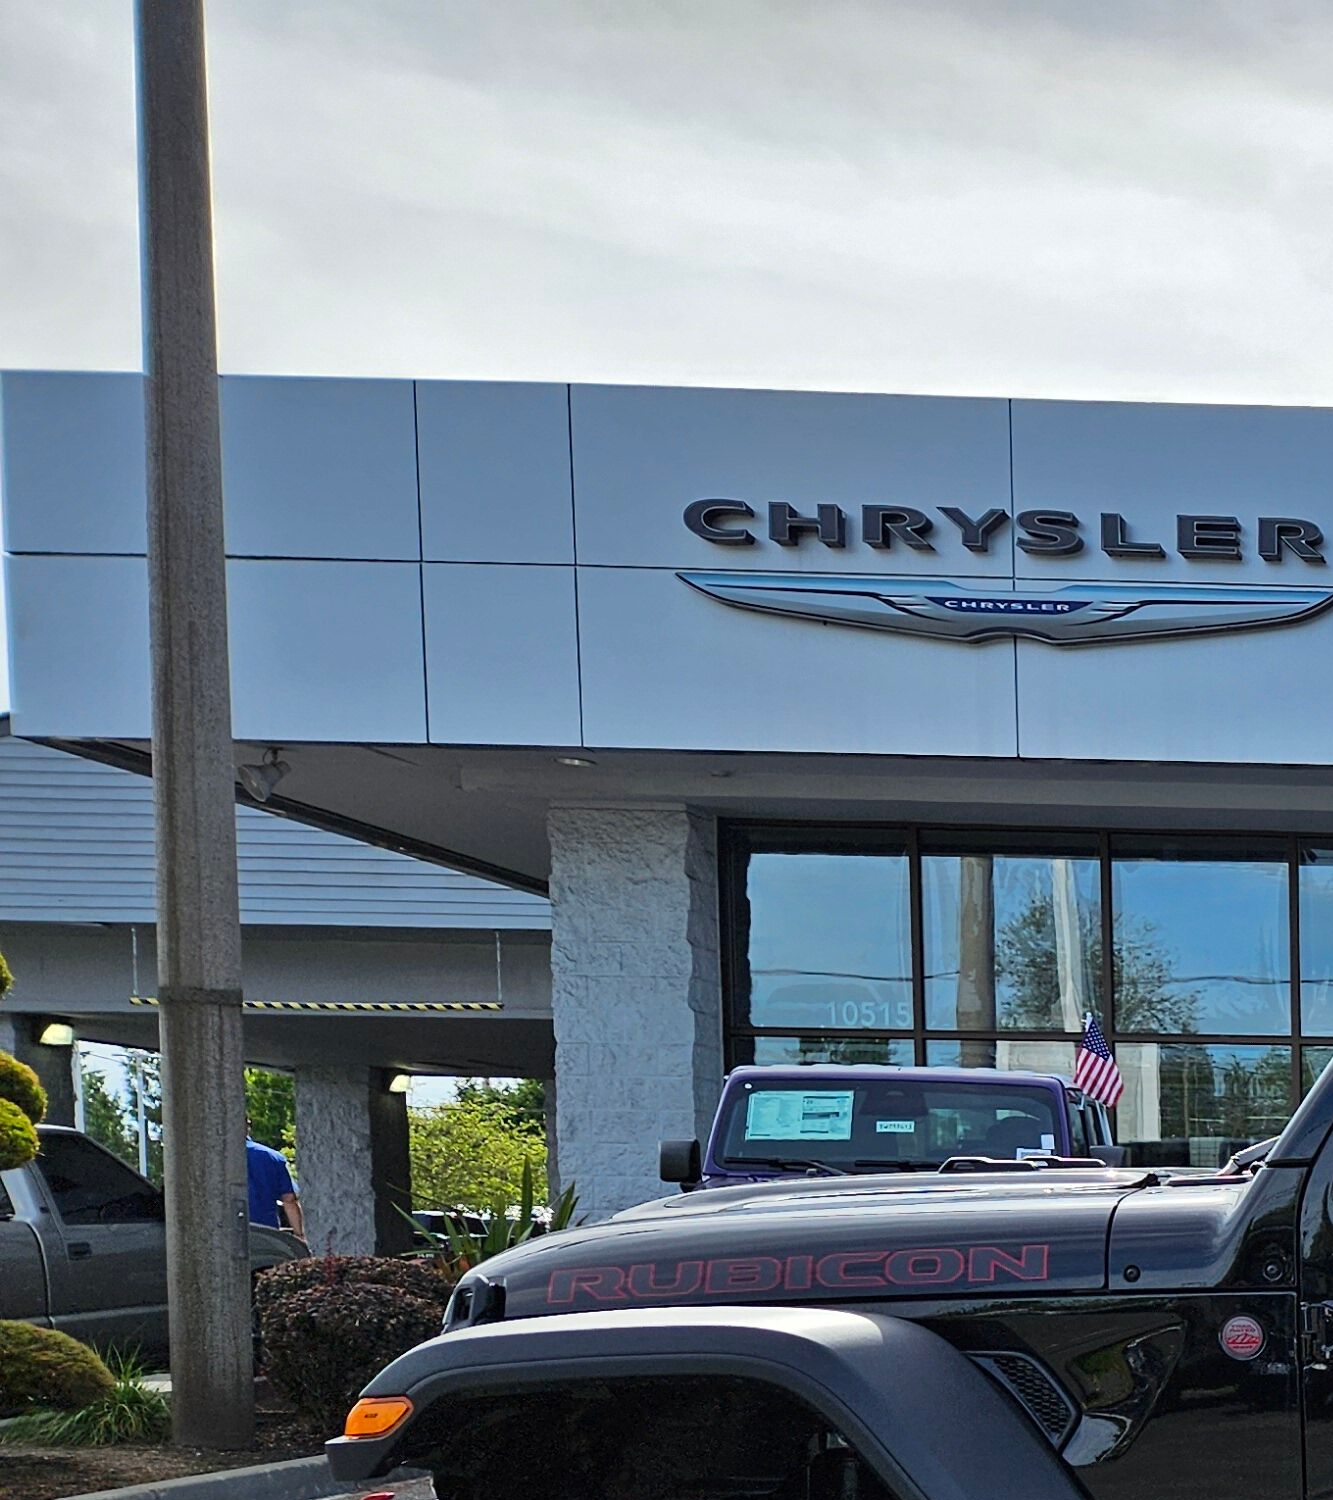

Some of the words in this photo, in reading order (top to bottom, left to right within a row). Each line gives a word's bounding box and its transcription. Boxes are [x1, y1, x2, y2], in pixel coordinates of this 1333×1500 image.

[683, 498, 1326, 564] CHRYSLER
[944, 600, 1070, 611] CHRYSLER
[826, 1000, 912, 1027] 10515
[547, 1244, 1049, 1302] RUBICON
